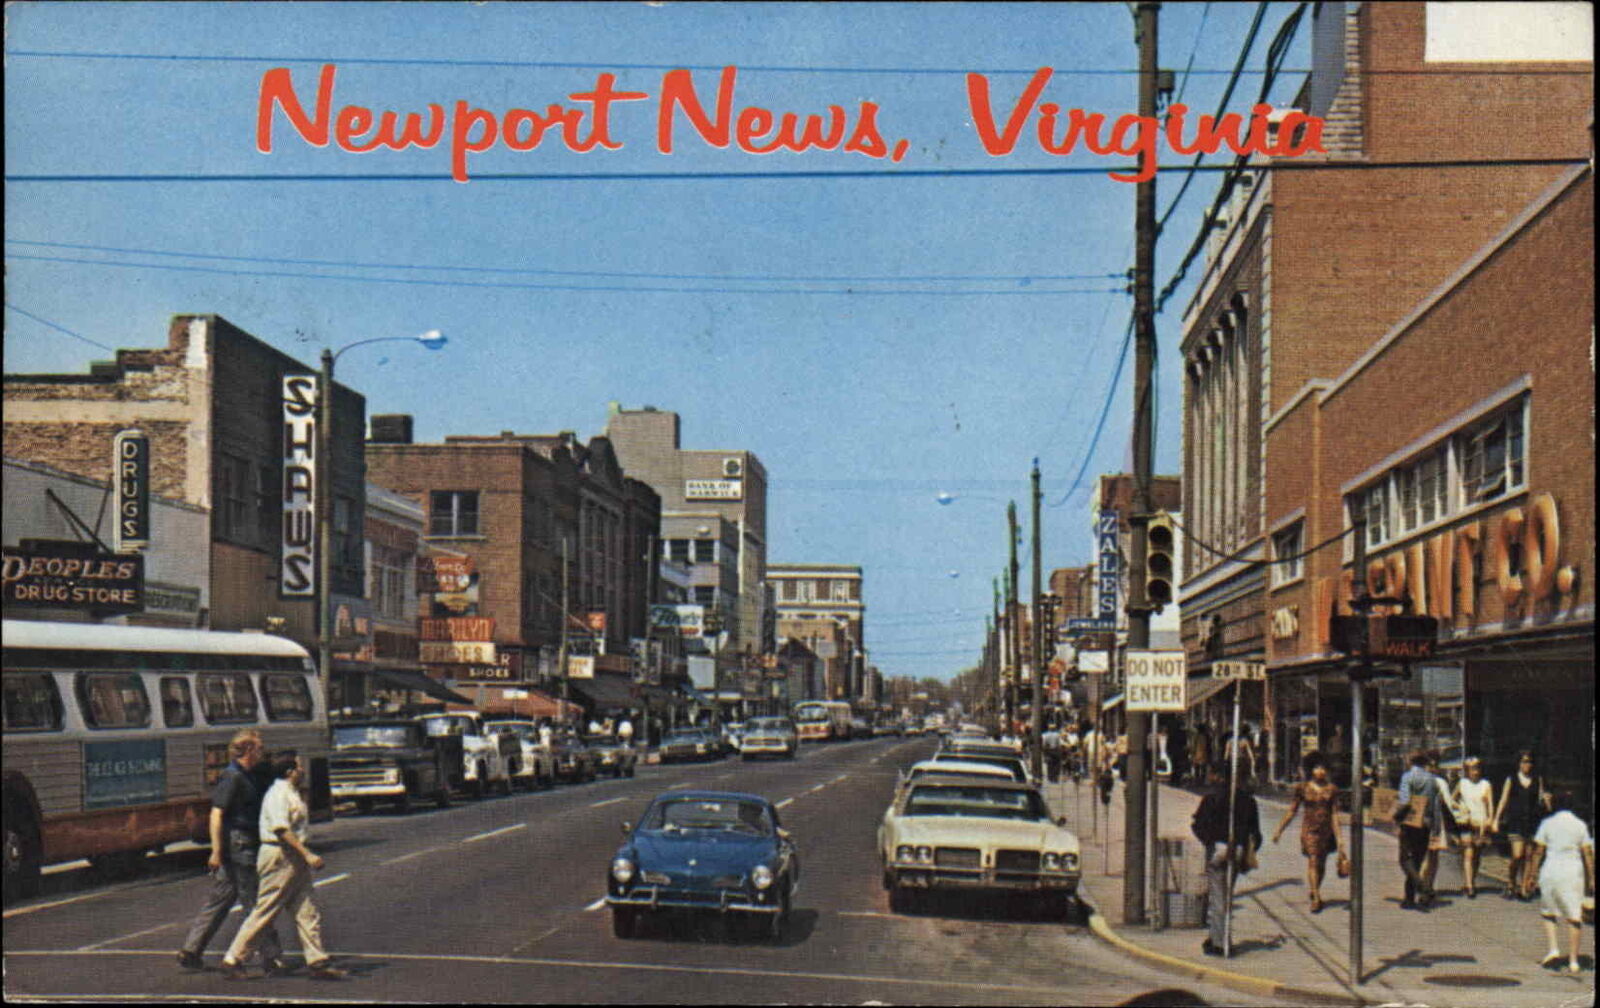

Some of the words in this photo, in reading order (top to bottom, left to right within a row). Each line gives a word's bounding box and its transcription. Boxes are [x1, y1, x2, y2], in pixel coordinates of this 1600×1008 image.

[121, 441, 138, 537] DRUGS
[1498, 491, 1574, 602] CO.
[2, 555, 136, 583] PEOPLES
[1100, 516, 1116, 613] ZALES
[15, 584, 68, 601] DRUG
[71, 587, 137, 604] STORE
[1384, 641, 1431, 657] WALK
[468, 667, 510, 678] SHOES
[1128, 658, 1148, 677] DO
[1152, 658, 1183, 677] NOT
[1129, 685, 1181, 703] ENTER
